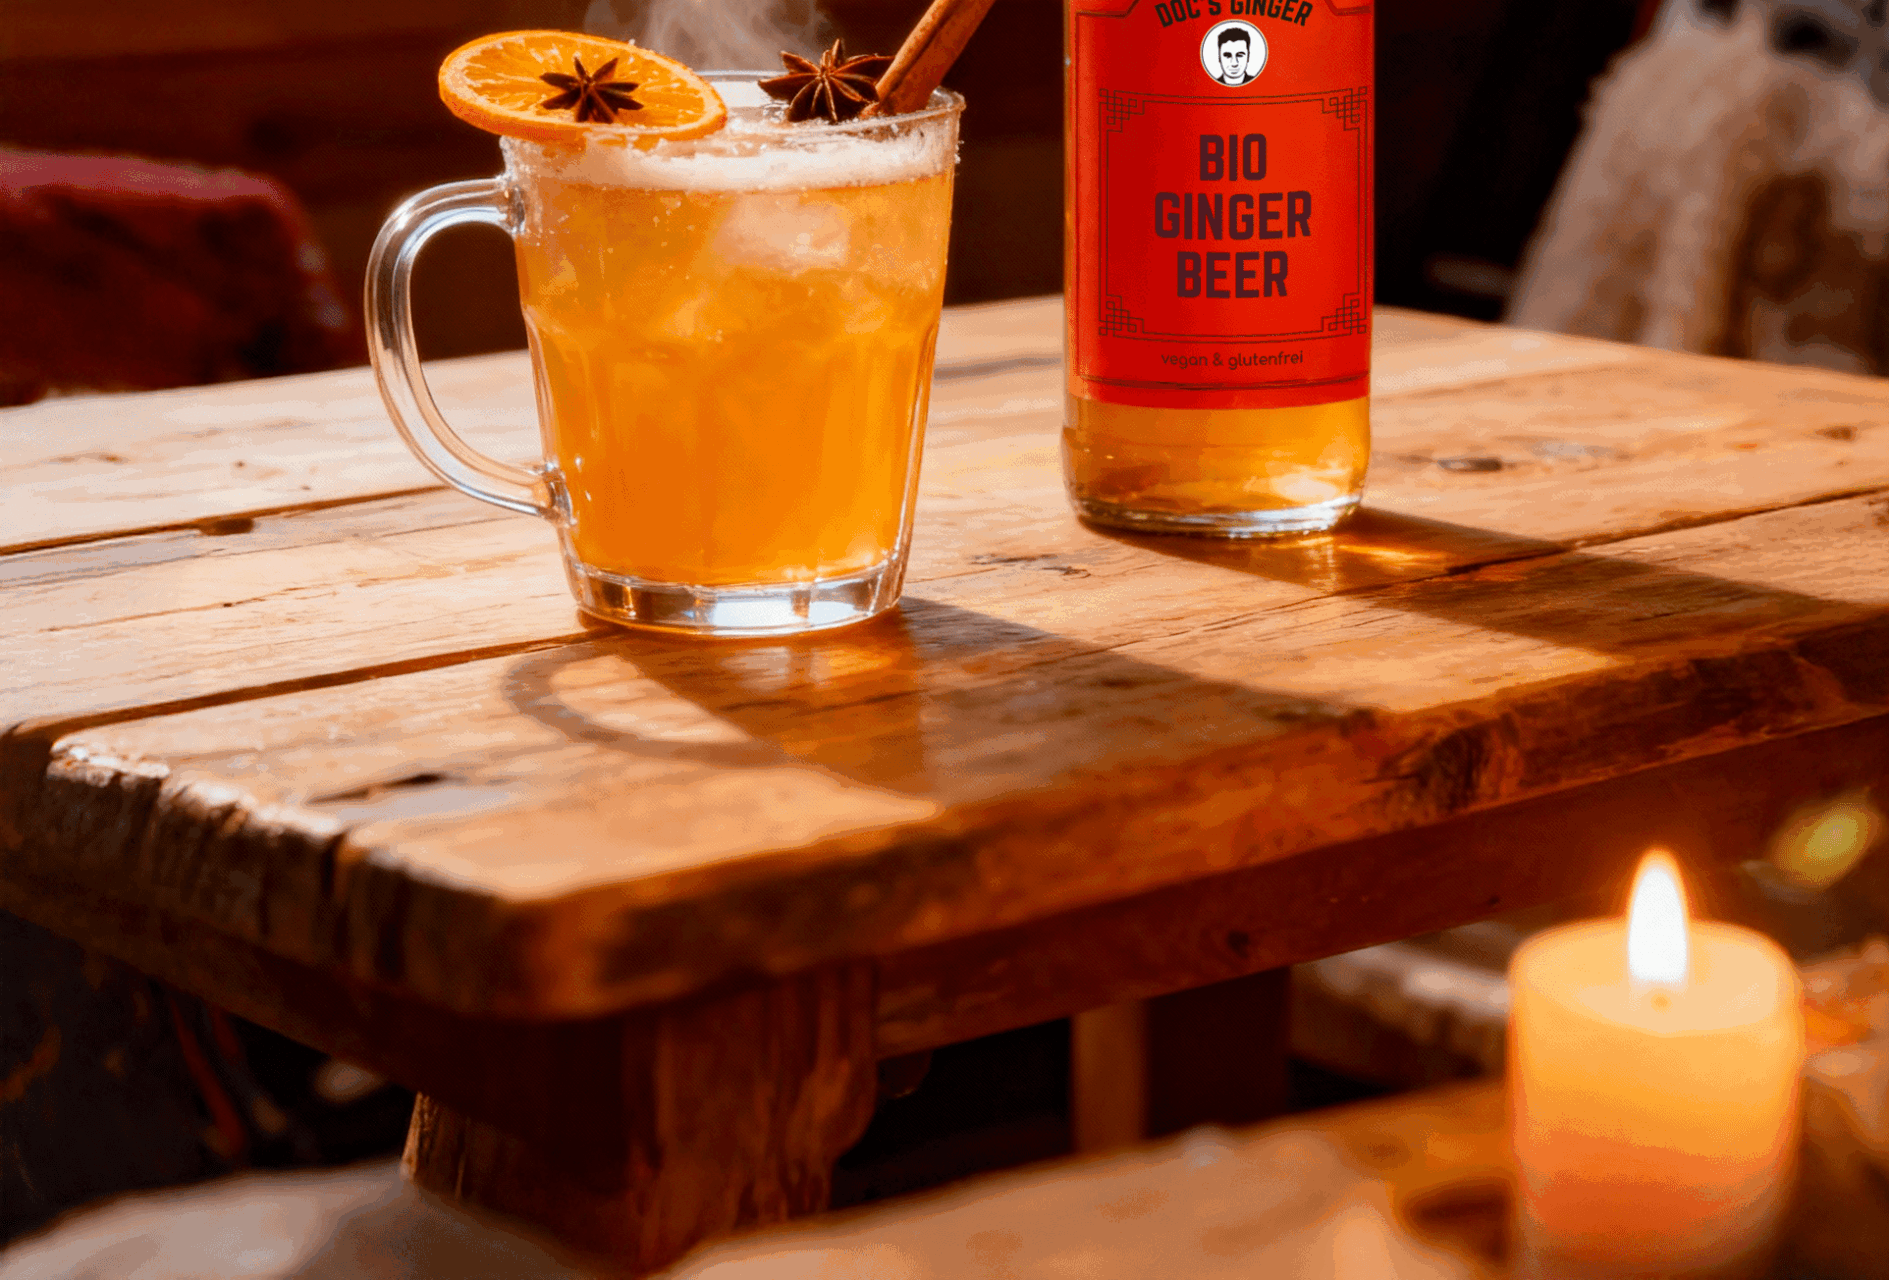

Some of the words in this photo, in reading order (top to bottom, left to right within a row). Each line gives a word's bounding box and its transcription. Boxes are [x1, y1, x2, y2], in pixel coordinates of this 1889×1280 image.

[1199, 133, 1267, 181] BIO
[1155, 190, 1312, 240] GINGER
[1177, 251, 1289, 299] BEER
[1160, 352, 1209, 369] vegan
[1212, 352, 1224, 367] &
[1228, 350, 1304, 371] glutenfrei
